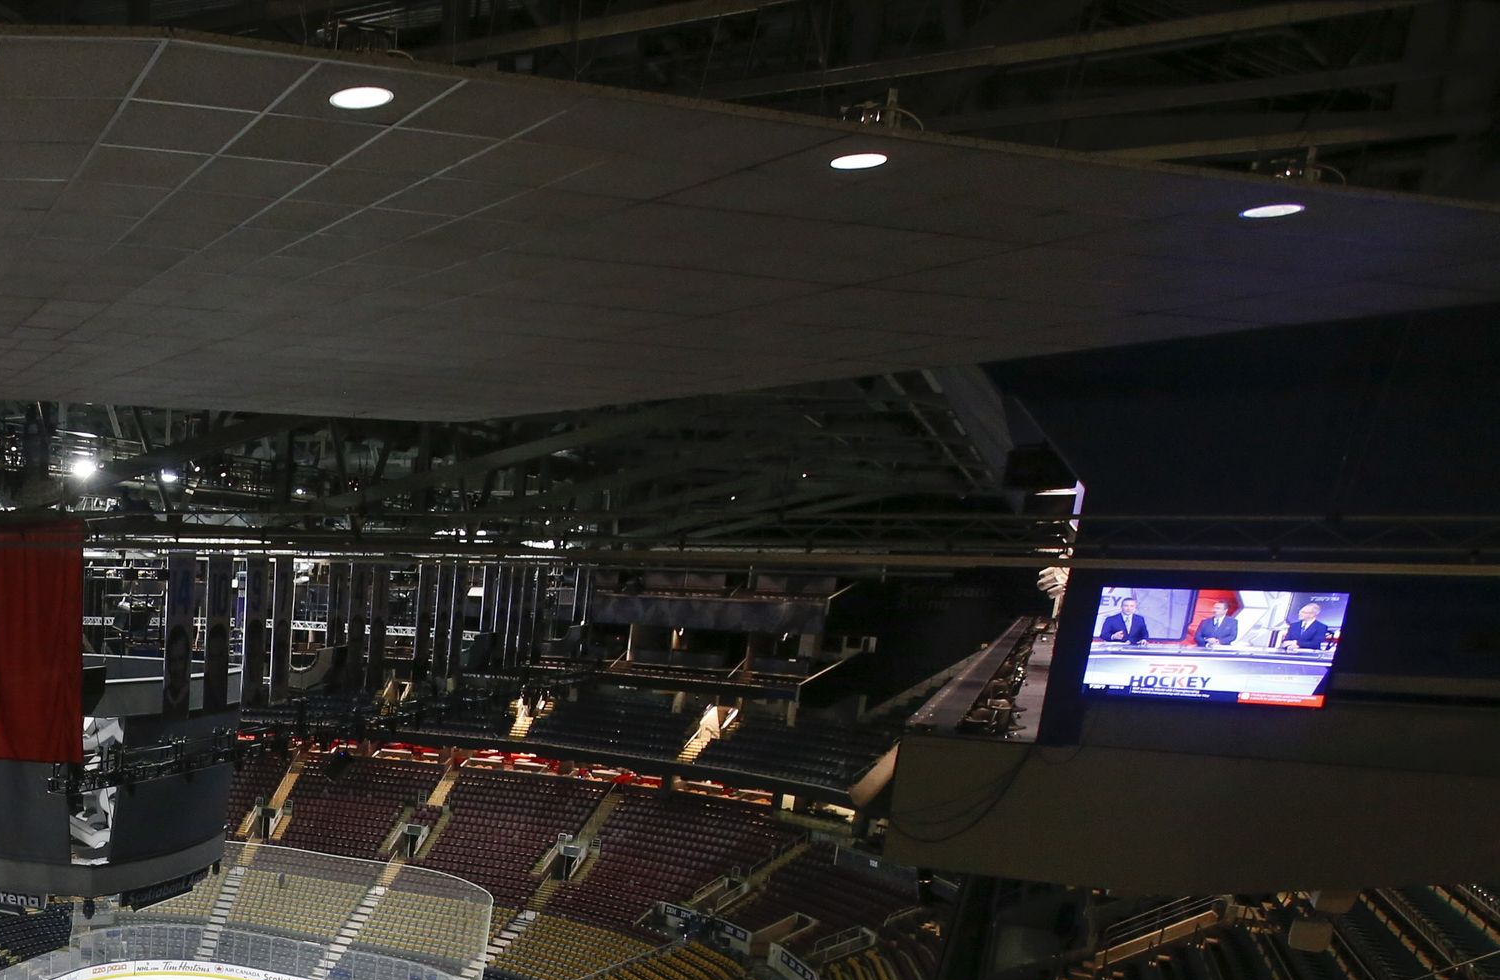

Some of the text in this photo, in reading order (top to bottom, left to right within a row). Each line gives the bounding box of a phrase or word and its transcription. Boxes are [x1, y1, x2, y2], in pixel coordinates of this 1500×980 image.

[171, 569, 191, 616] 14
[213, 571, 229, 616] 10
[1148, 664, 1199, 675] TSN
[1129, 675, 1212, 689] HOCKEY
[162, 961, 211, 974] Tim Hortons
[235, 968, 261, 978] CANADA
